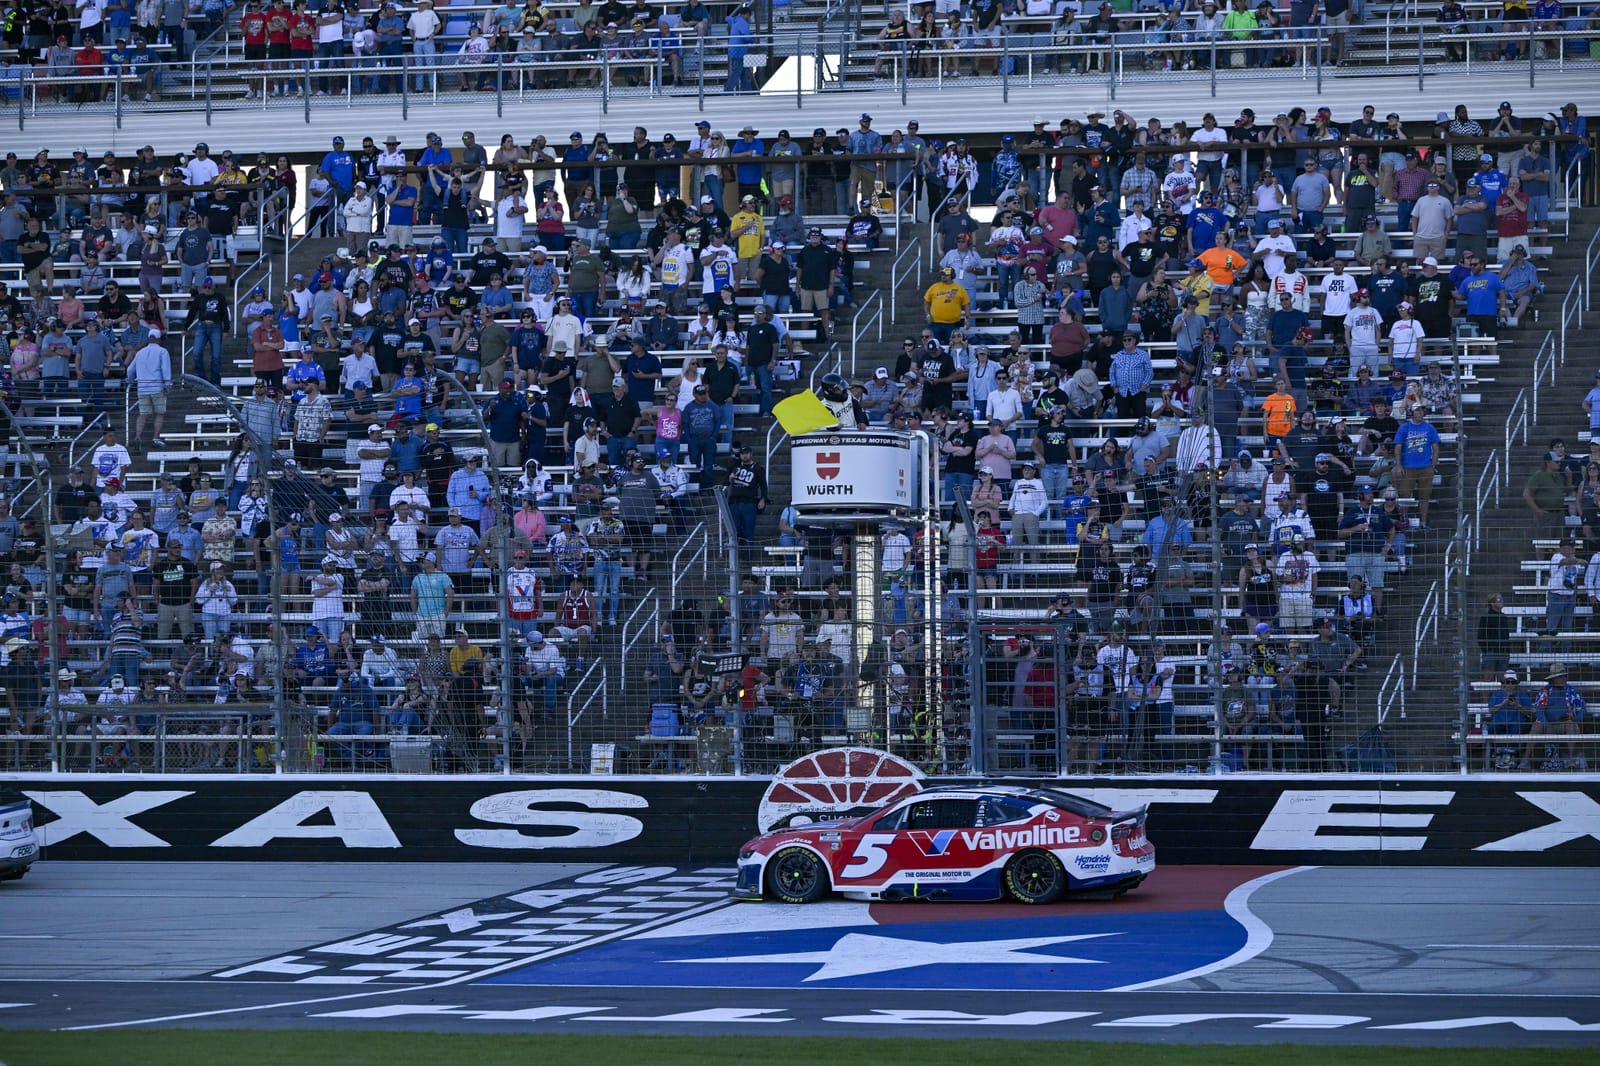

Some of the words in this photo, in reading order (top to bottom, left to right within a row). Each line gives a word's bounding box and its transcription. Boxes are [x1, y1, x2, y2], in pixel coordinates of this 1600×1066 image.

[1331, 279, 1345, 287] JUST
[923, 360, 942, 370] MAN
[960, 824, 1081, 851] Valvoline
[17, 846, 32, 857] FORD
[840, 833, 898, 878] 5
[1075, 853, 1112, 865] Hendrick
[1080, 862, 1109, 871] Cars.com
[211, 866, 678, 978] TEXAS
